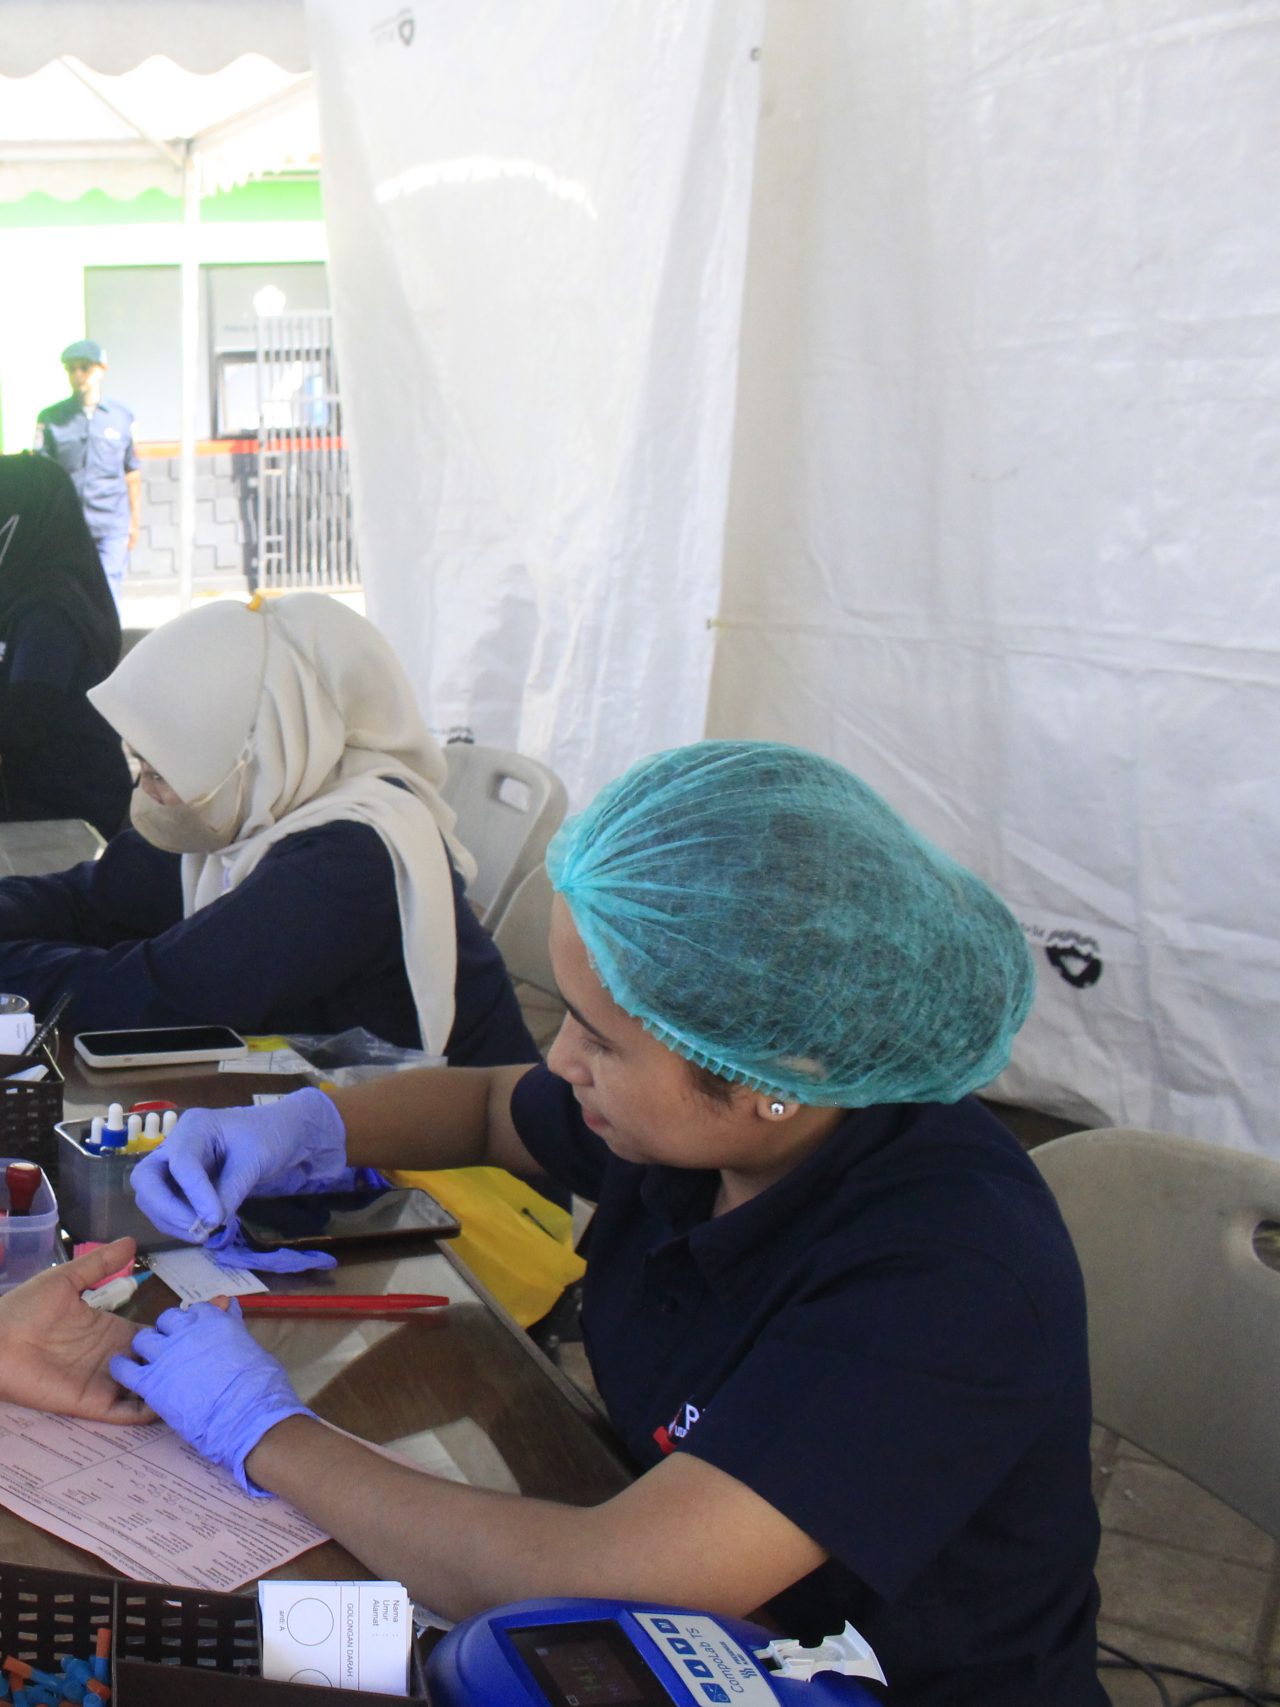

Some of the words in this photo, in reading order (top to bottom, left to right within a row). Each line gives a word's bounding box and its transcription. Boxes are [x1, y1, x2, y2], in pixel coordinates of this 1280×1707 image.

[372, 1599, 380, 1627] Alamat
[382, 1600, 391, 1621] Umur
[392, 1600, 400, 1623] Nama
[346, 1603, 354, 1648] GOLONGAN
[686, 1627, 703, 1639] TS
[346, 1649, 354, 1677] DARAH
[700, 1641, 744, 1693] CompoLab
